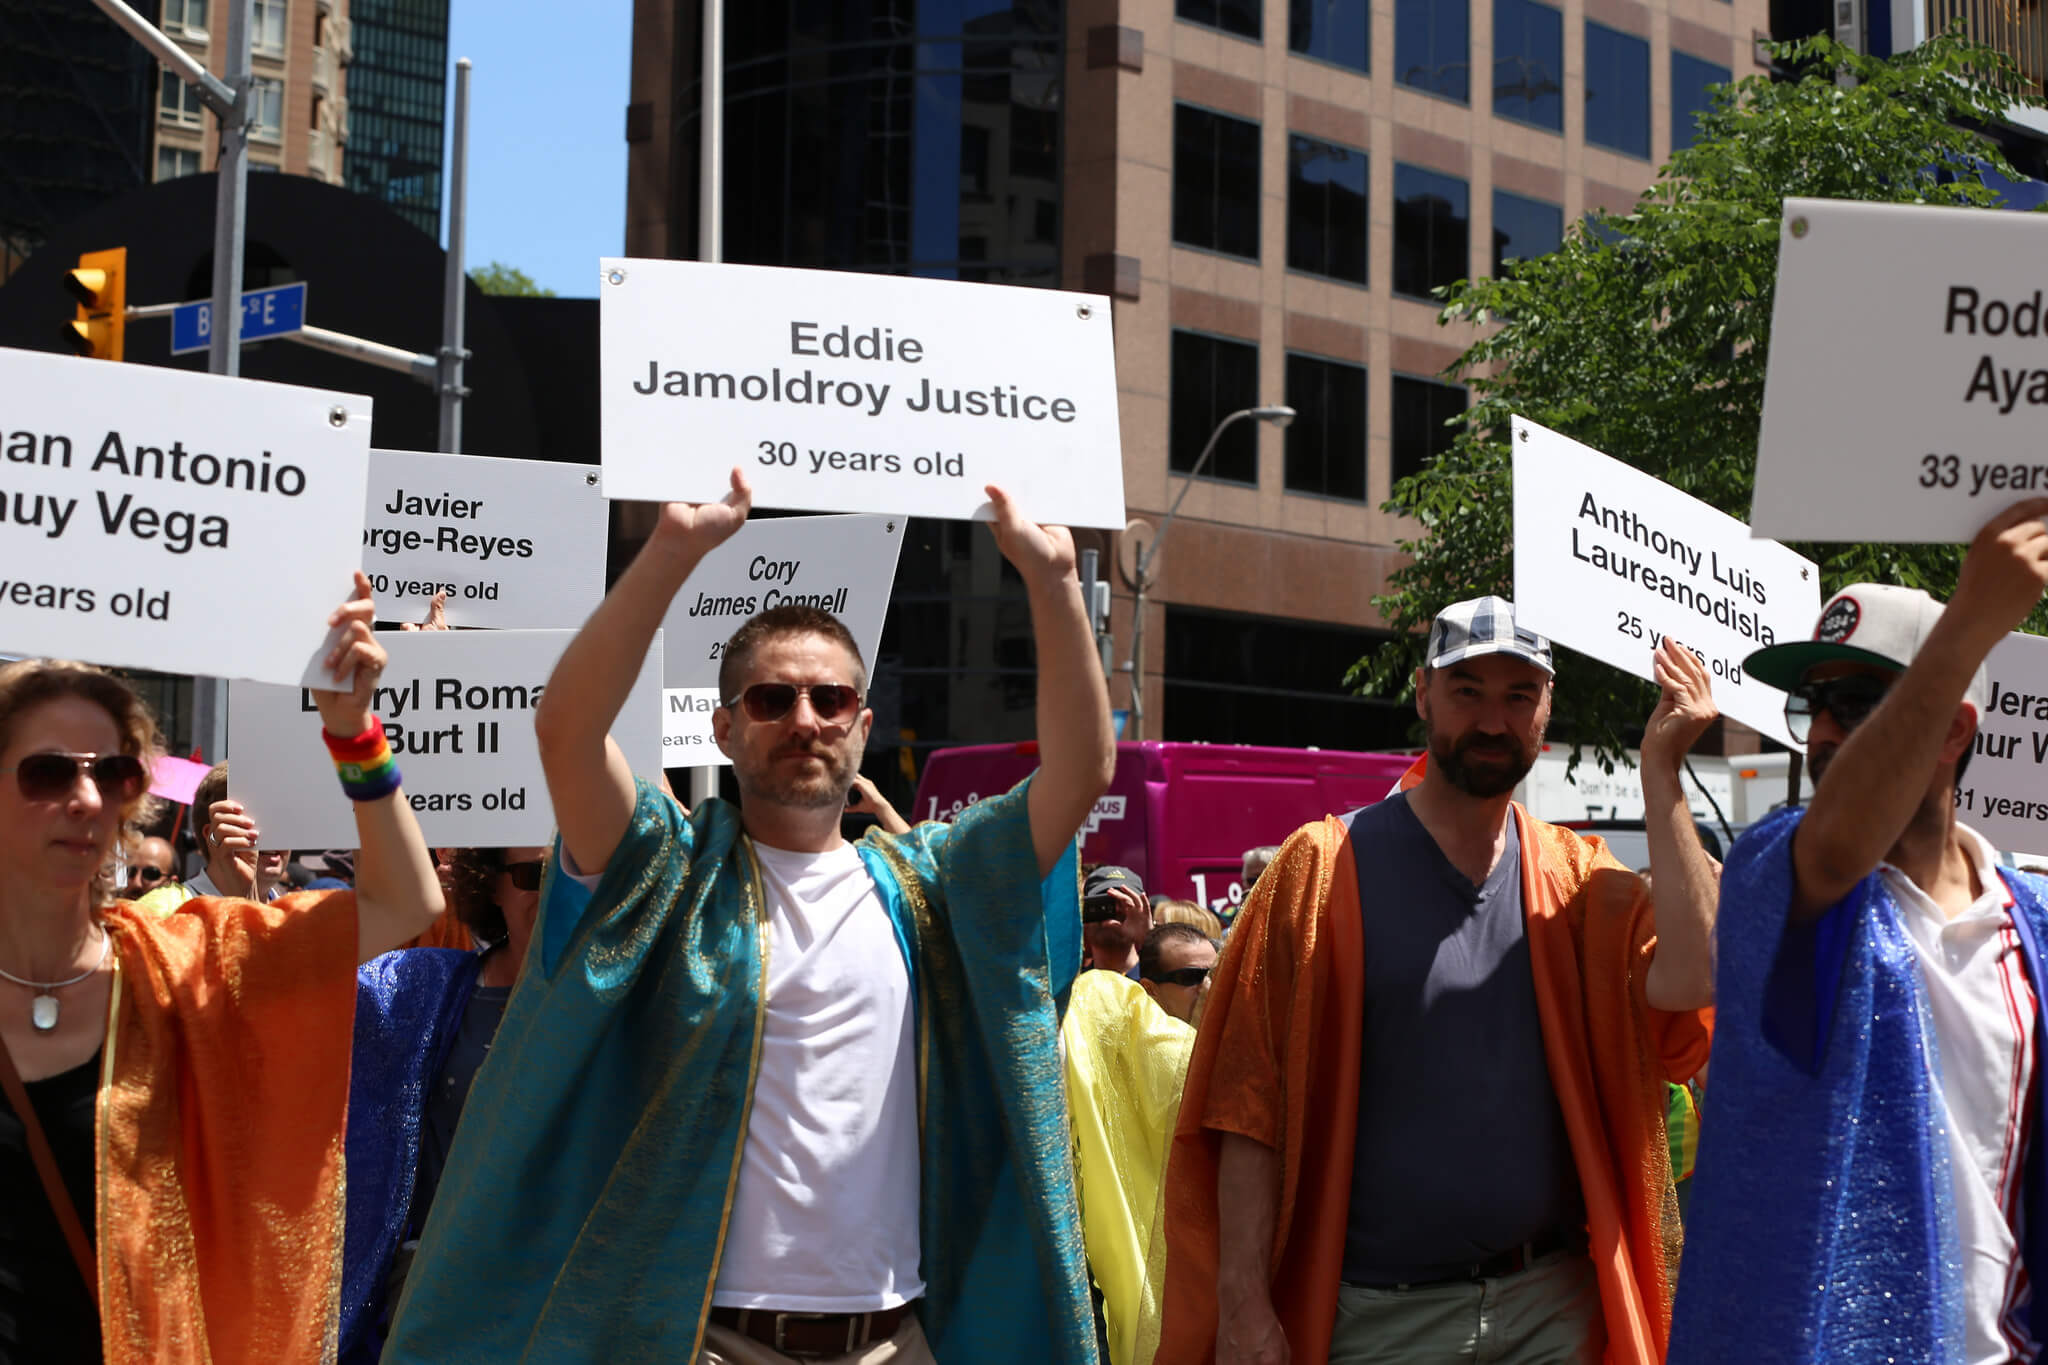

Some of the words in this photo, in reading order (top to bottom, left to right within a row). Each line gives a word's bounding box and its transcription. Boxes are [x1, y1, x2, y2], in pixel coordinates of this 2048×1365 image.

[263, 293, 277, 326] E
[1944, 286, 2048, 338] Rod
[790, 321, 924, 363] Eddie
[632, 361, 891, 417] Jamoldroy
[906, 378, 1077, 423] Justice
[0, 430, 72, 468] an
[91, 431, 307, 497] Antonio
[757, 440, 798, 467] 30
[808, 447, 901, 474] years
[913, 452, 965, 478] old
[1919, 454, 1960, 489] 33
[386, 489, 484, 519] Javier
[96, 490, 230, 554] Vega
[1578, 491, 1702, 576] Anthony
[1712, 551, 1767, 605] Luis
[749, 555, 801, 586] Cory
[1572, 527, 1775, 647] Laureanodisla
[110, 588, 170, 621] old
[395, 580, 457, 598] years
[464, 582, 499, 601] old
[689, 592, 757, 617] James
[1617, 611, 1643, 639] 25
[1712, 658, 1742, 686] old
[1985, 681, 2048, 721] Jera
[383, 722, 463, 755] Burt
[477, 722, 499, 754] II
[662, 734, 703, 746] ears
[482, 787, 526, 811] old
[1982, 795, 2048, 822] years
